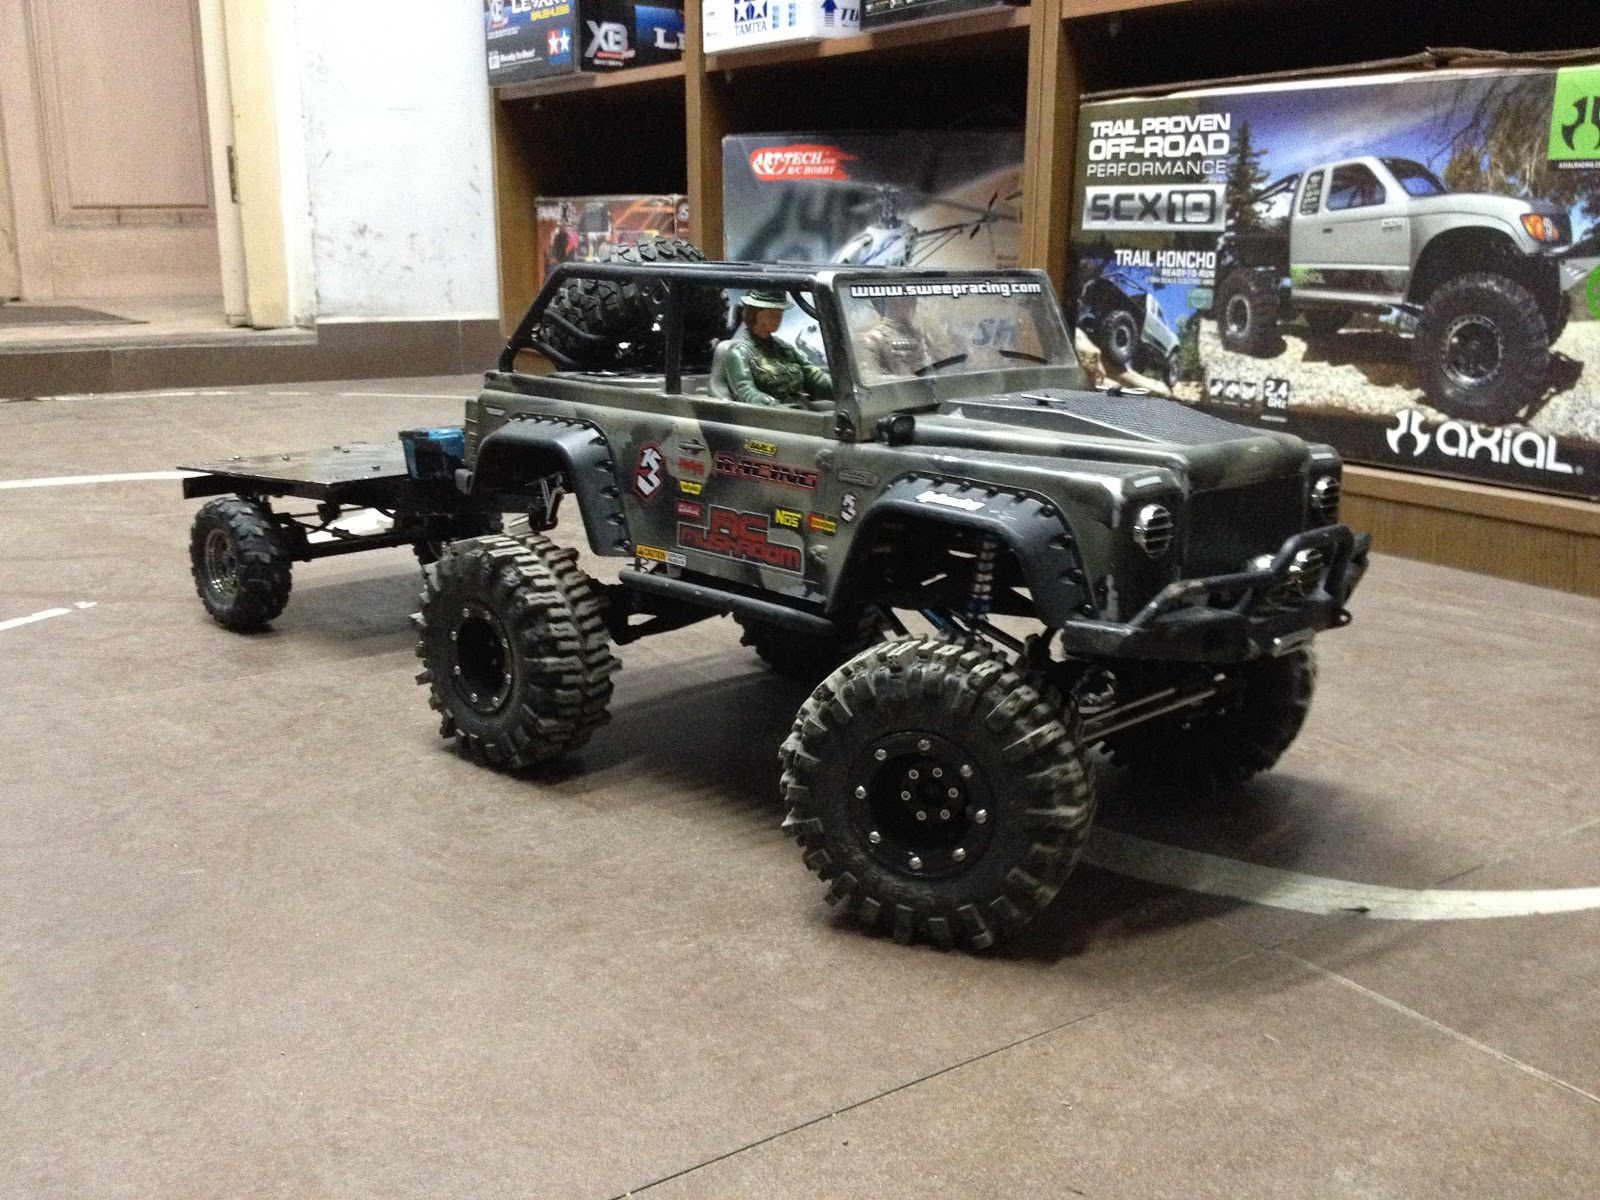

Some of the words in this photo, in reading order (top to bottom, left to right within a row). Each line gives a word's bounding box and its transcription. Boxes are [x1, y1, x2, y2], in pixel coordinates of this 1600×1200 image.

[734, 21, 767, 36] TAMIYA
[1090, 119, 1140, 138] TRAIL
[1142, 112, 1231, 135] PROVEN
[1088, 133, 1230, 161] OFF-ROAD
[803, 165, 835, 176] HOBBY
[1087, 159, 1228, 177] PERFORMANCE
[1090, 189, 1217, 225] SCX10
[1114, 249, 1153, 267] TRAIL
[1156, 250, 1217, 269] HONCHO
[851, 281, 1042, 298] www.sweepracing.com
[1265, 379, 1288, 399] 2.4
[715, 453, 820, 491] RACING
[711, 507, 768, 543] RC
